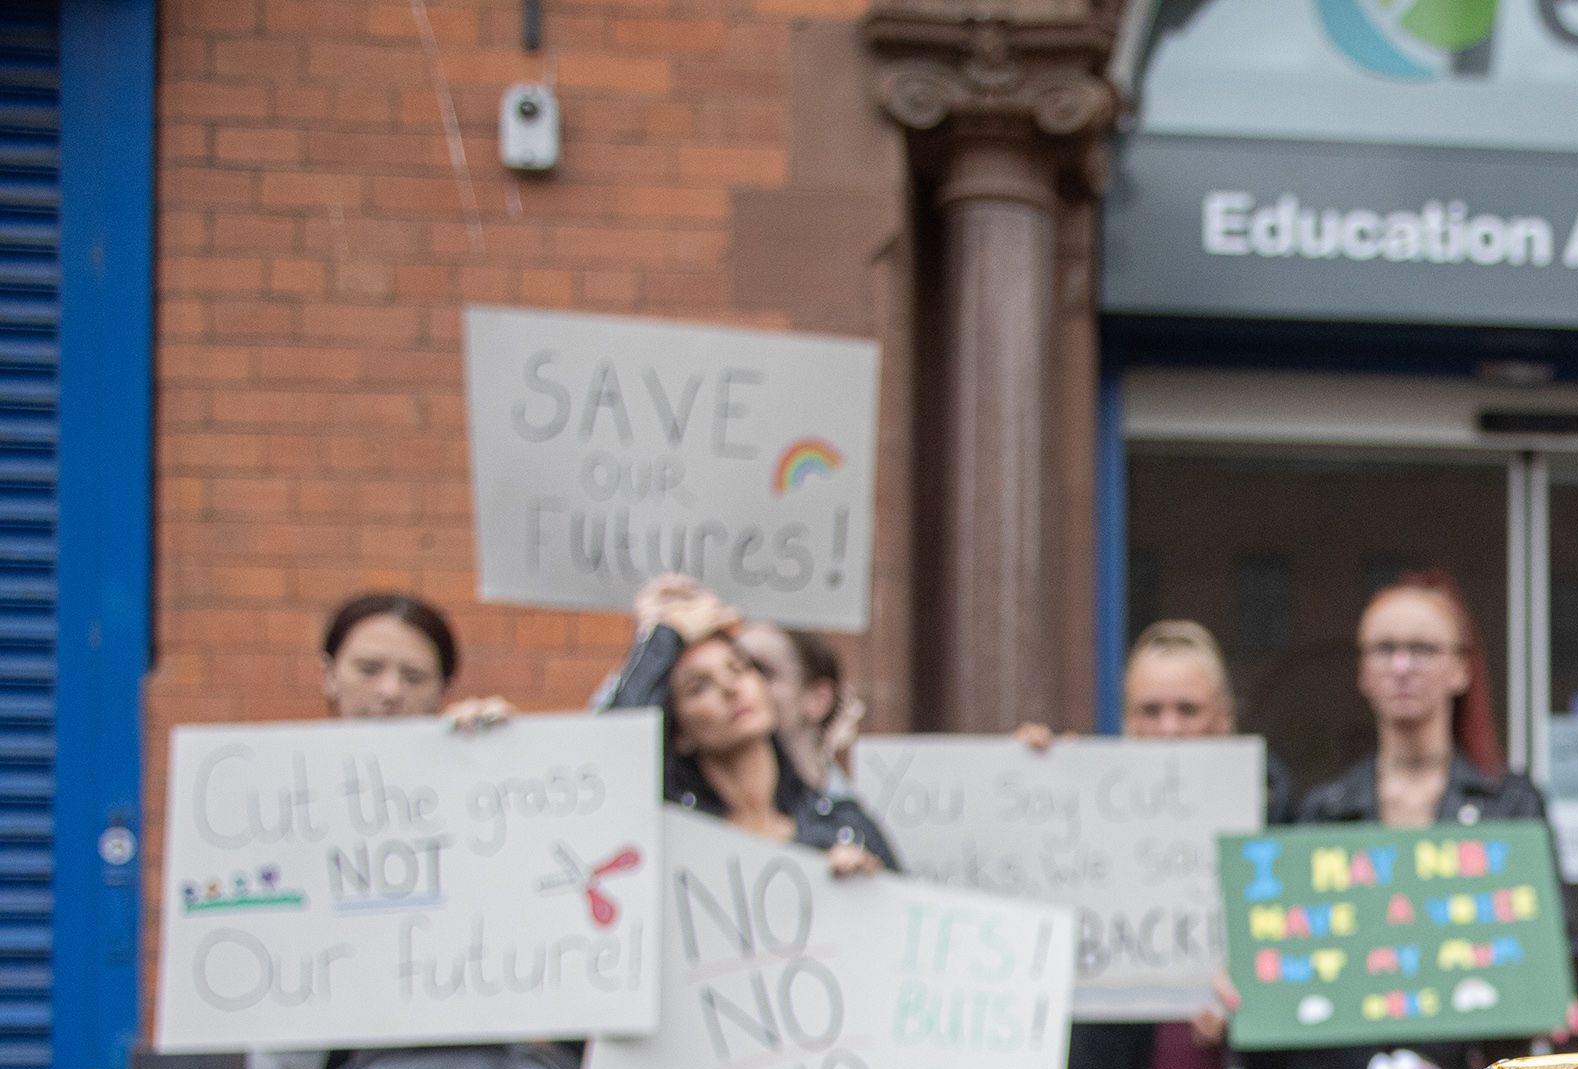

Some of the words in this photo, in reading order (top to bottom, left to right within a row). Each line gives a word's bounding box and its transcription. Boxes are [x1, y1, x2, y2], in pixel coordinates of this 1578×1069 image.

[1202, 190, 1553, 267] Education
[510, 347, 768, 461] SAVE
[580, 449, 699, 509] OUR
[193, 743, 329, 849] Cut
[342, 752, 447, 837] the
[464, 764, 607, 858] grass
[863, 748, 965, 829] You
[327, 832, 454, 899] NOT
[1242, 839, 1284, 901] I
[1310, 844, 1398, 893] MAY
[1413, 838, 1510, 880] NOT
[672, 856, 815, 963] NO
[1247, 901, 1358, 941] HAVE
[1386, 892, 1416, 926] A
[193, 926, 356, 1012] Our
[1254, 946, 1348, 984] BUT
[701, 954, 846, 1061] NO
